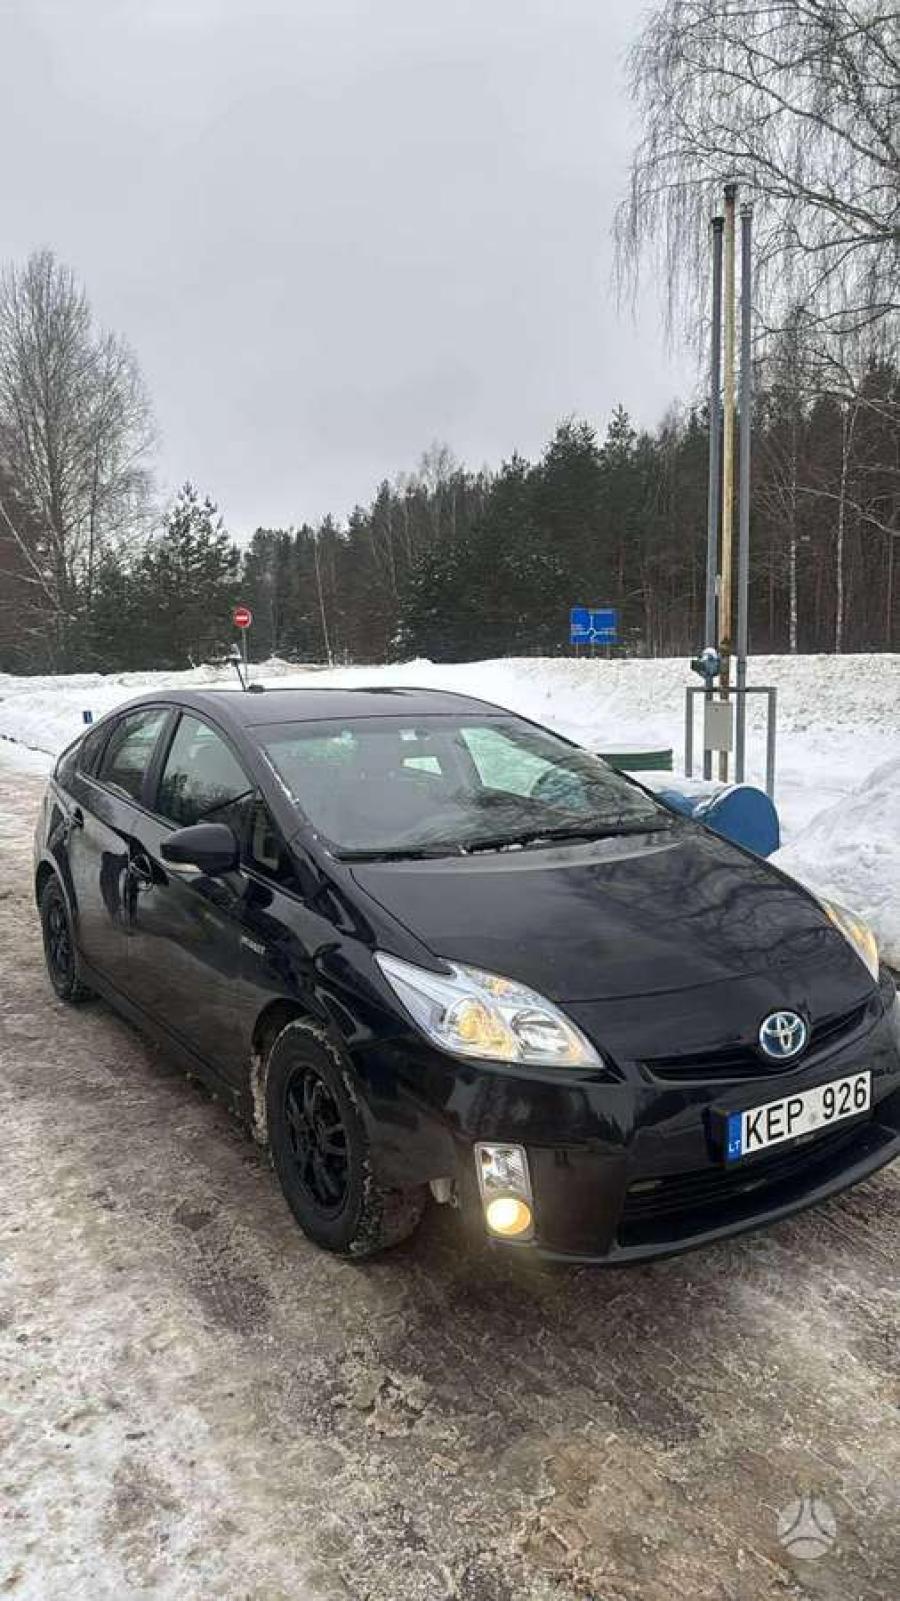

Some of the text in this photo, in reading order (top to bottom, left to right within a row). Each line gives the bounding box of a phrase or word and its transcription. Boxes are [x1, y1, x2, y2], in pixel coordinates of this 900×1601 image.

[746, 1077, 866, 1149] KEP 926
[729, 1139, 740, 1152] LT
